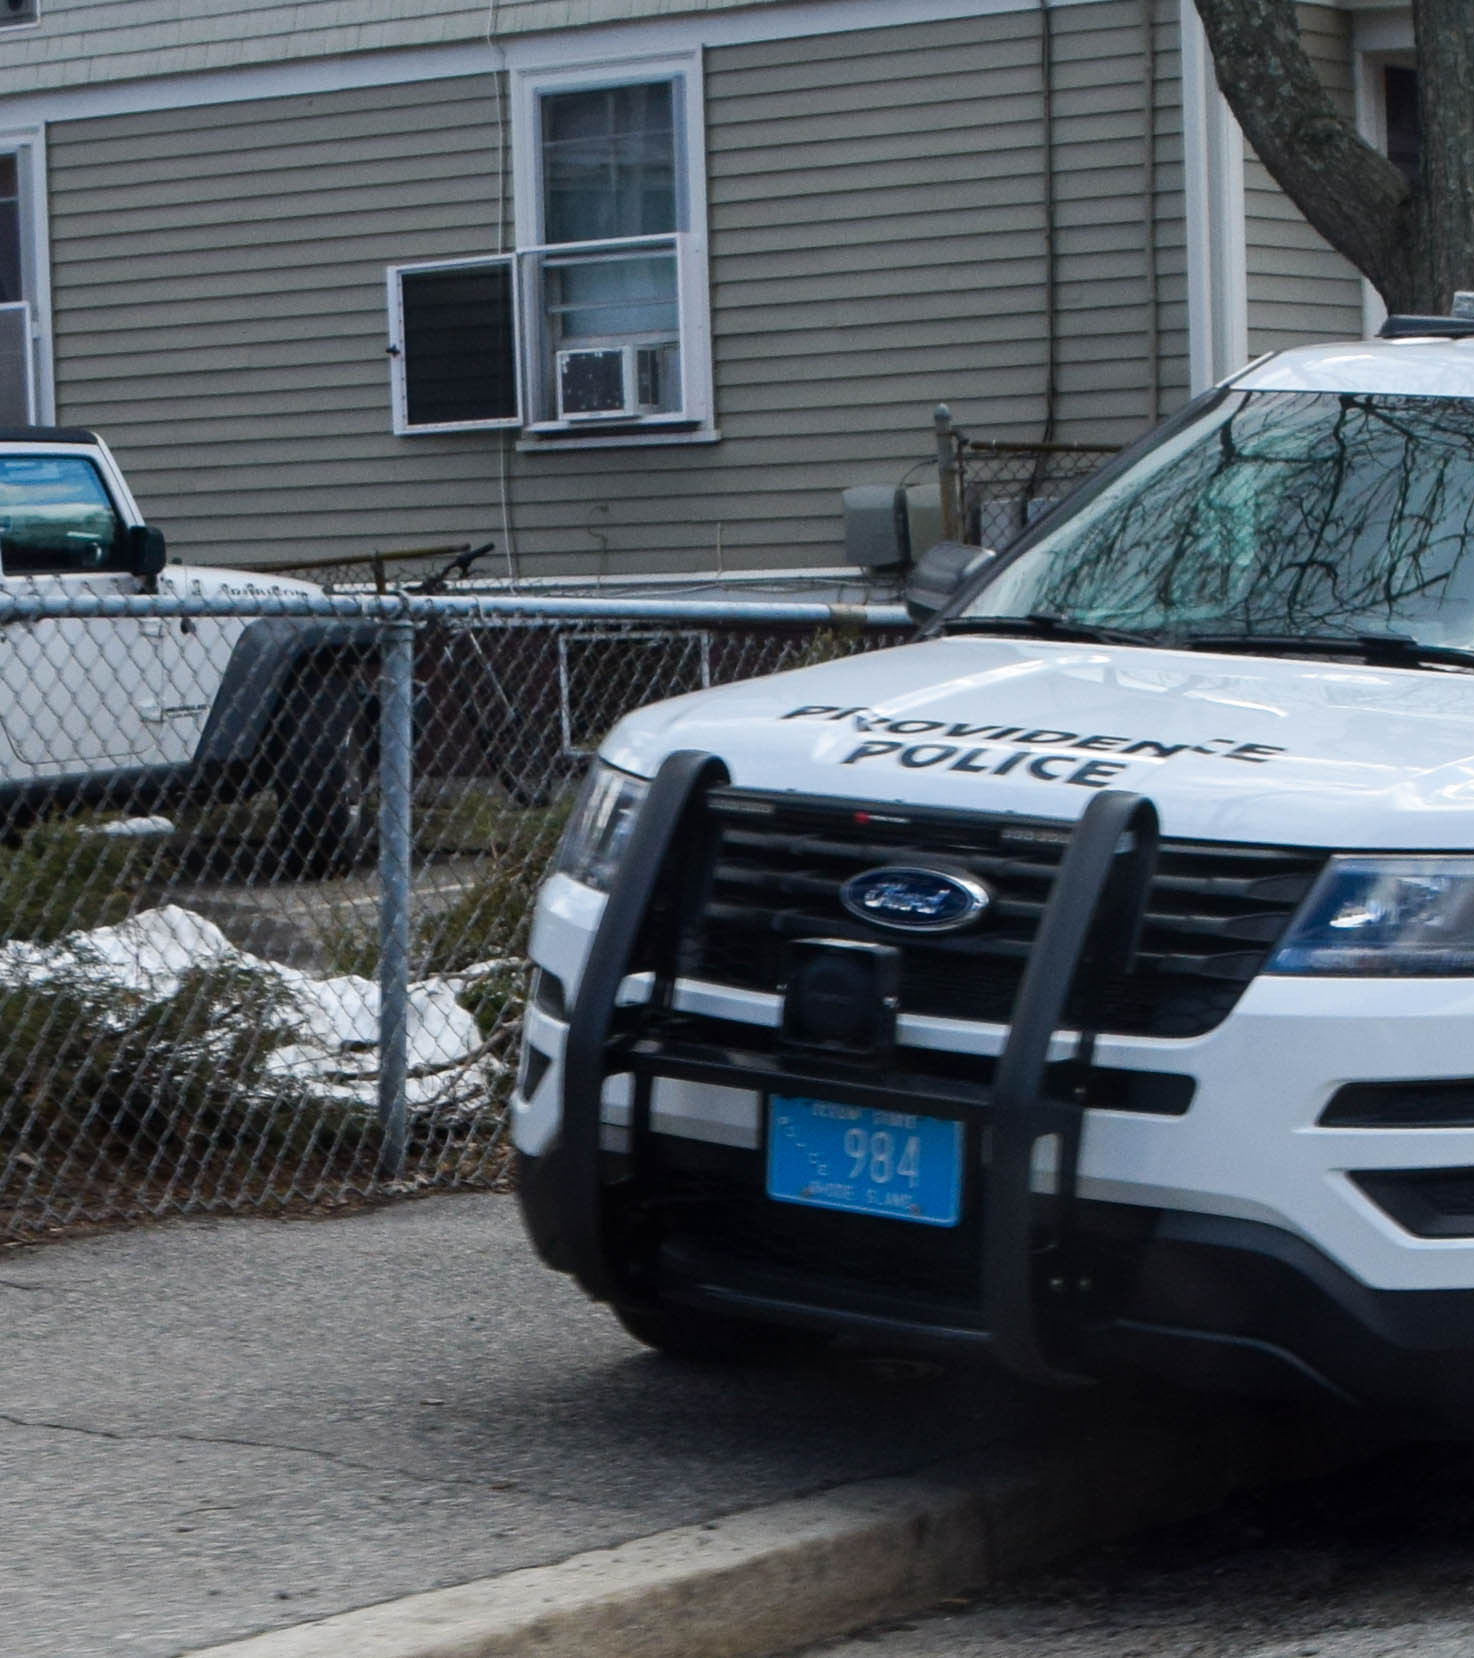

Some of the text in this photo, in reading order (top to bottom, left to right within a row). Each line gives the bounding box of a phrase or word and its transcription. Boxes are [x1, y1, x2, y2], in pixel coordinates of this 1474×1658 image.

[781, 704, 1288, 763] PROVIDENCE
[841, 740, 1129, 788] POLICE
[843, 1126, 921, 1189] 984
